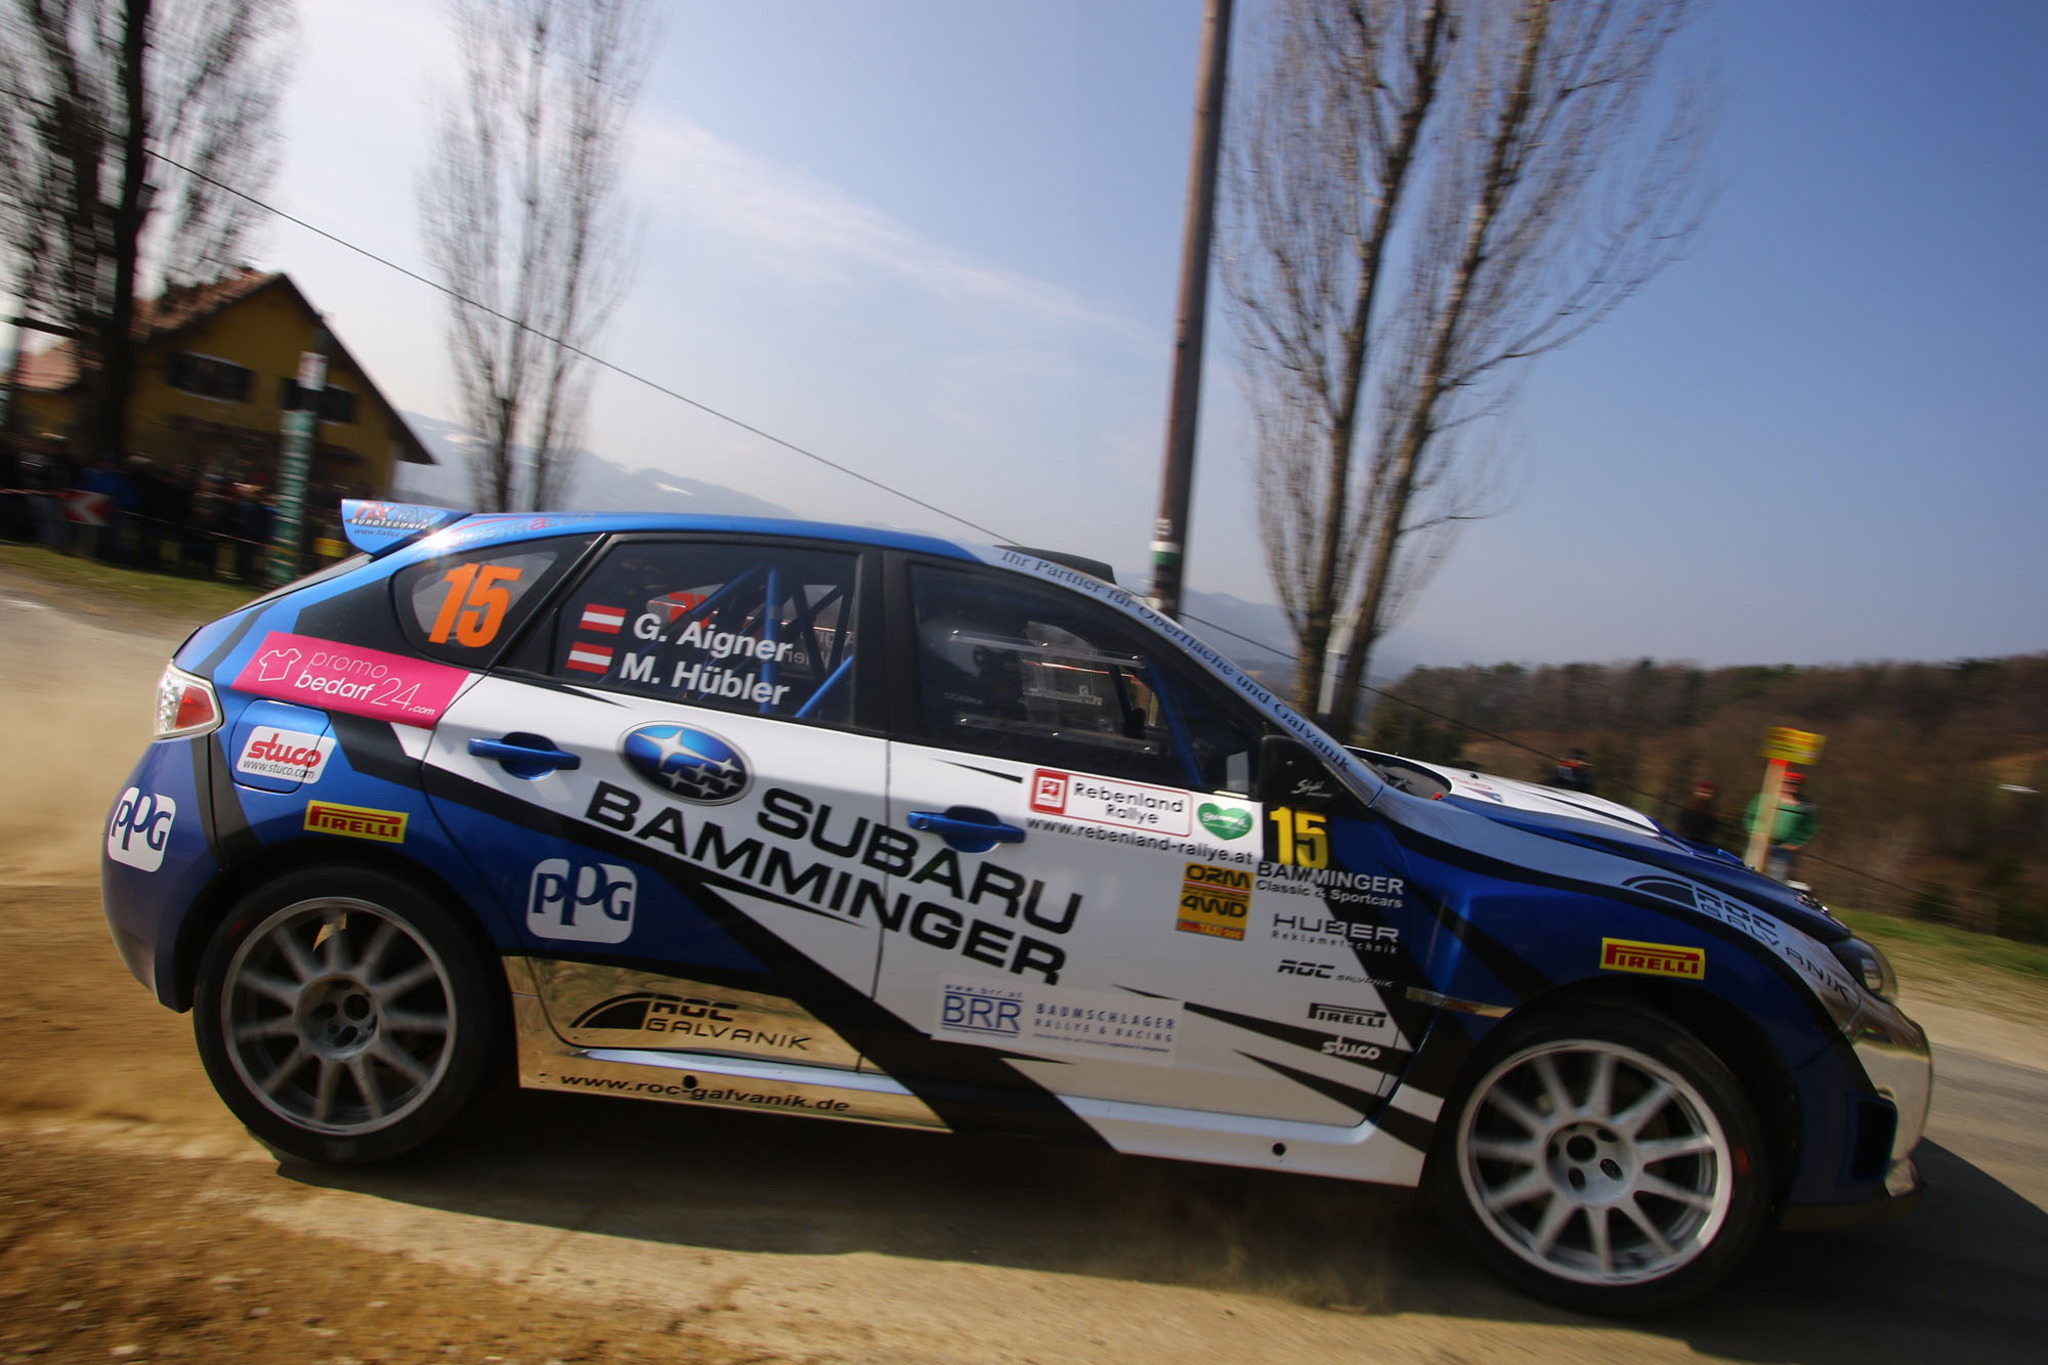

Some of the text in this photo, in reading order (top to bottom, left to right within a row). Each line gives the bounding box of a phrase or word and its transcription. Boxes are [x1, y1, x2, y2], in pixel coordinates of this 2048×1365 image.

[428, 563, 522, 649] 15
[633, 613, 668, 642] G.
[676, 621, 793, 663] Aigner
[306, 651, 389, 680] promo
[1000, 549, 1030, 567] Ihr
[1034, 560, 1103, 593] Partner
[1104, 582, 1133, 608] für
[1236, 674, 1271, 705] und
[1274, 702, 1353, 774] Galvanik
[619, 652, 791, 705] M. Hübler
[247, 733, 322, 768] stuco
[242, 758, 316, 780] www.stuco.com
[1073, 782, 1185, 813] Rebenland
[308, 805, 403, 838] PIRELLI
[1105, 804, 1160, 825] Rallye
[1026, 816, 1254, 865] www.rebenland-rallye.at
[1269, 806, 1329, 870] 15
[756, 787, 1083, 935] SUBARU
[1185, 865, 1251, 889] ORM
[584, 780, 1068, 985] BAMMINGER
[1255, 879, 1311, 897] Classic
[1316, 887, 1327, 899] &
[1329, 889, 1403, 908] Sportcars
[1256, 861, 1405, 895] BAMMINGER
[1181, 894, 1248, 919] 4WD
[1271, 930, 1400, 954] Reklametechnik
[1273, 913, 1400, 943] HUBER
[1605, 943, 1700, 975] PIRELLI
[942, 994, 1023, 1031] BRR
[1036, 1003, 1175, 1029] BAUMSCHLAGER
[1308, 1002, 1387, 1028] PIRELLI
[646, 1017, 815, 1051] GALVANIK
[1321, 1035, 1381, 1060] stuco
[560, 1074, 850, 1112] www.roc-galvanik.de
